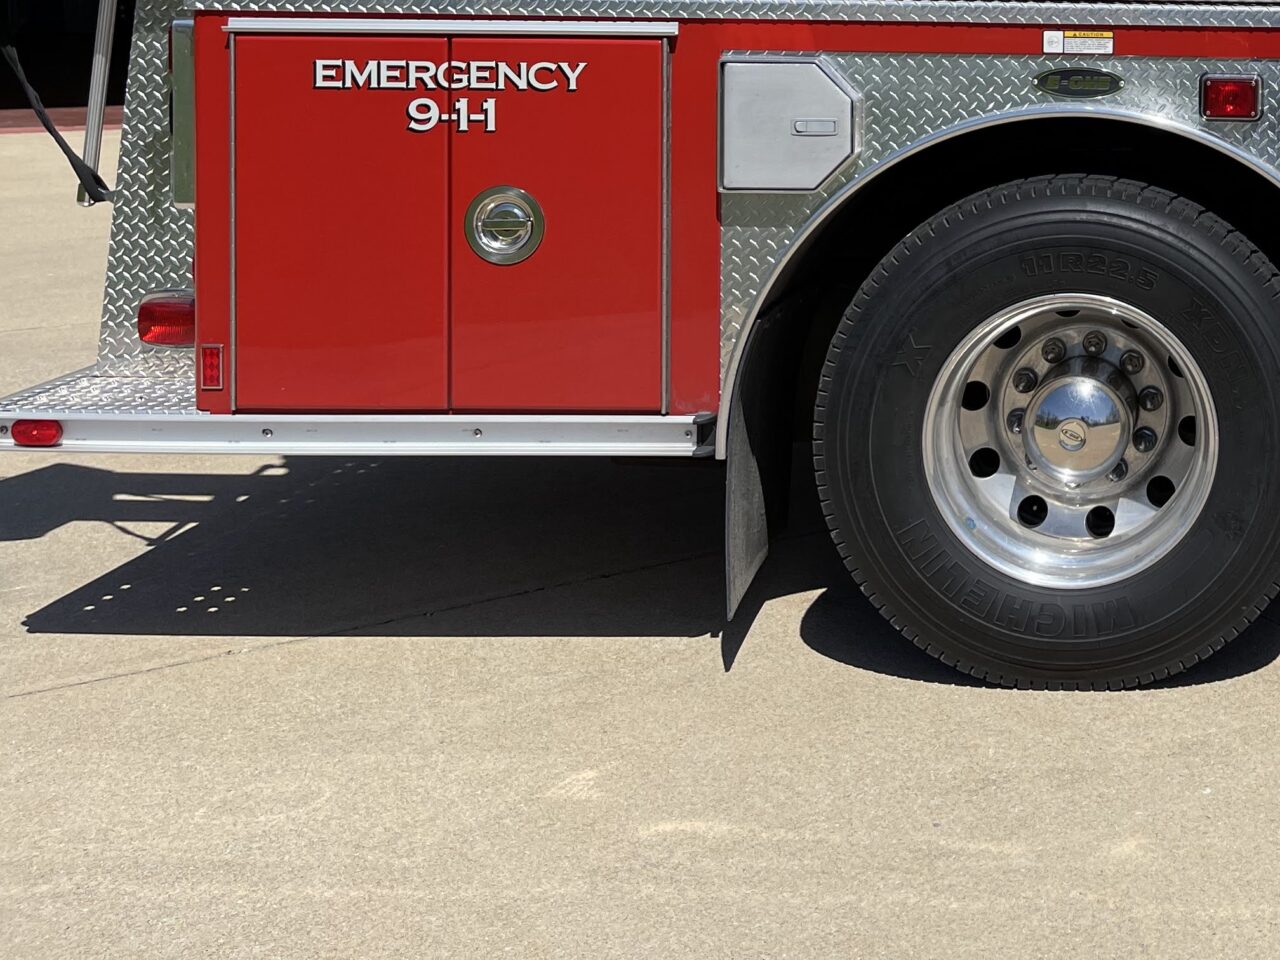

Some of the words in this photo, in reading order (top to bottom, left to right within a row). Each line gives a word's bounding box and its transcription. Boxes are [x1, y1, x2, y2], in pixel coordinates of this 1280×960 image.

[313, 59, 587, 90] EMERGENCY
[1045, 75, 1112, 90] E-ONE
[406, 97, 496, 132] 9-1-1
[1021, 251, 1159, 290] 11R22.5
[896, 518, 1139, 639] MICHELIN
